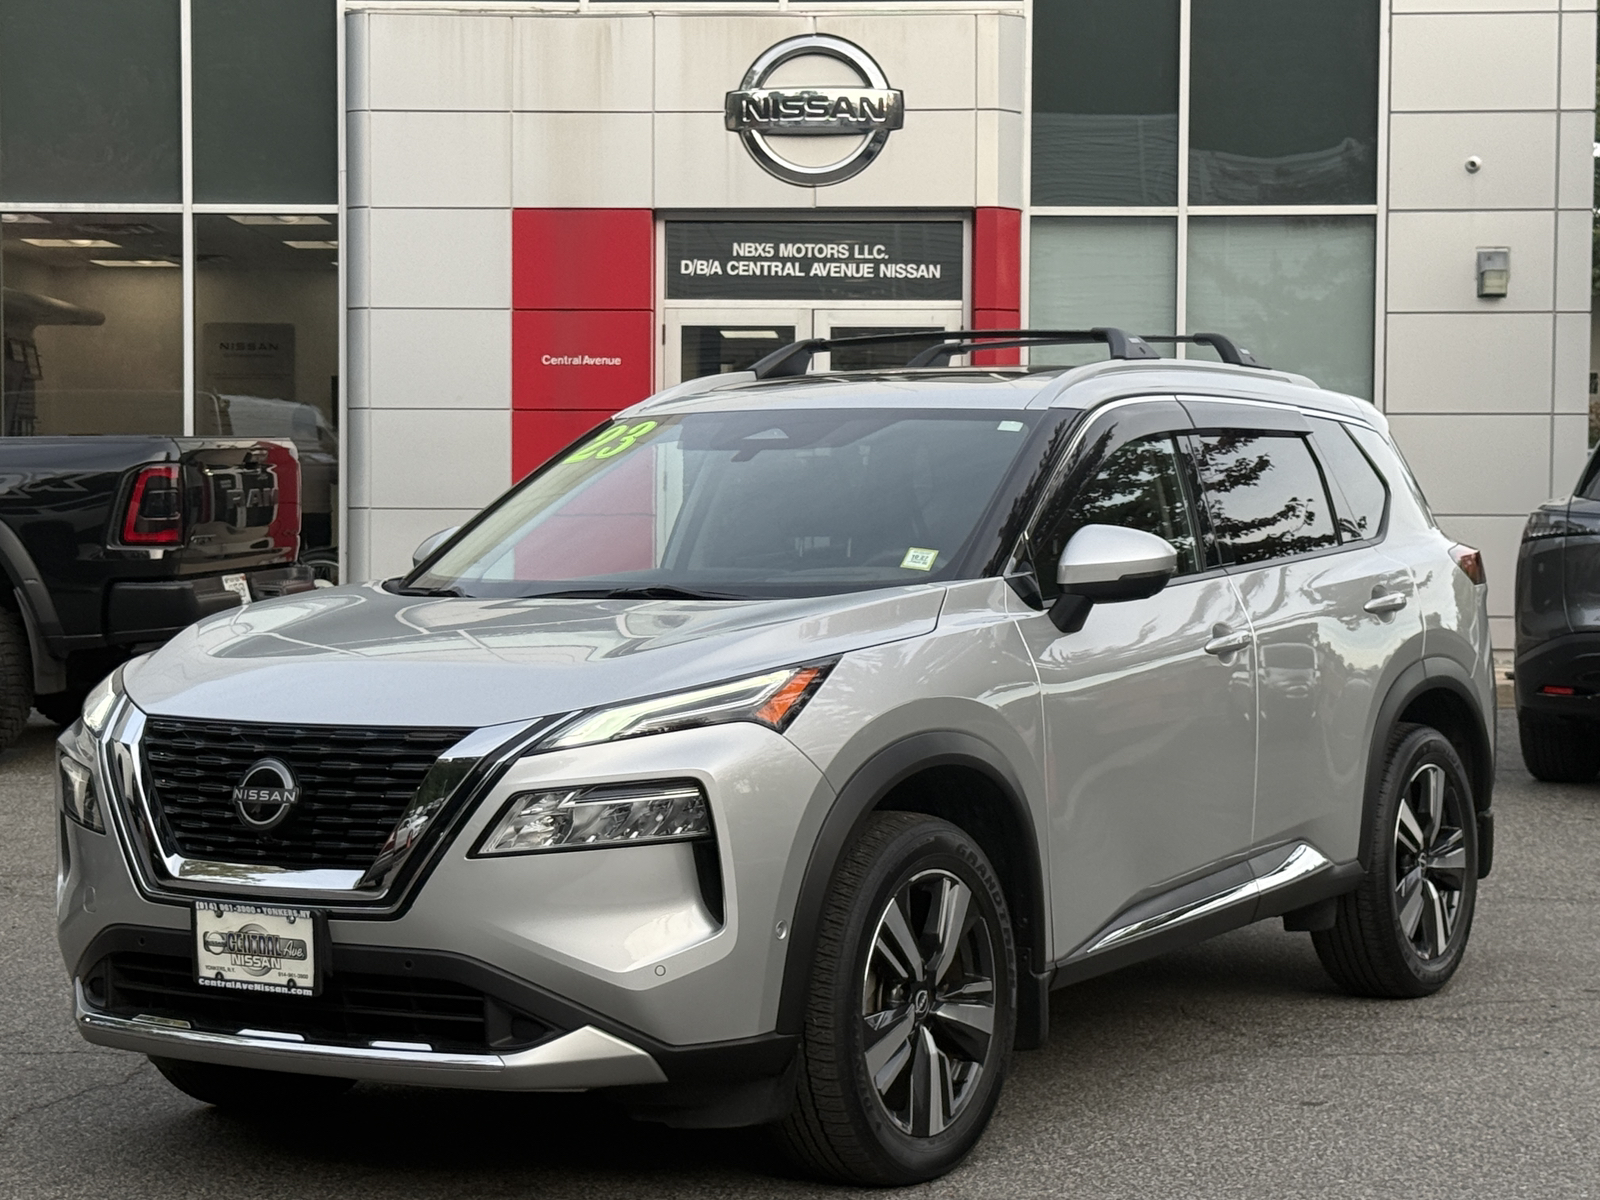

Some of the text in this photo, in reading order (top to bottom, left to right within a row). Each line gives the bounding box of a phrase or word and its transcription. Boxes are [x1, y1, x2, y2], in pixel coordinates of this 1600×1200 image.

[741, 96, 886, 122] NISSAN
[733, 243, 889, 259] NBX5 MOTORS LLC.
[680, 260, 941, 279] D/B/A CENTRAL AVENUE NISSAN
[219, 342, 279, 351] NISSAN
[541, 354, 622, 366] Central Avenue
[561, 420, 658, 465] 23
[234, 789, 296, 802] NISSAN
[231, 955, 281, 970] NISSAN
[198, 978, 313, 996] CentralAveNissan.com
